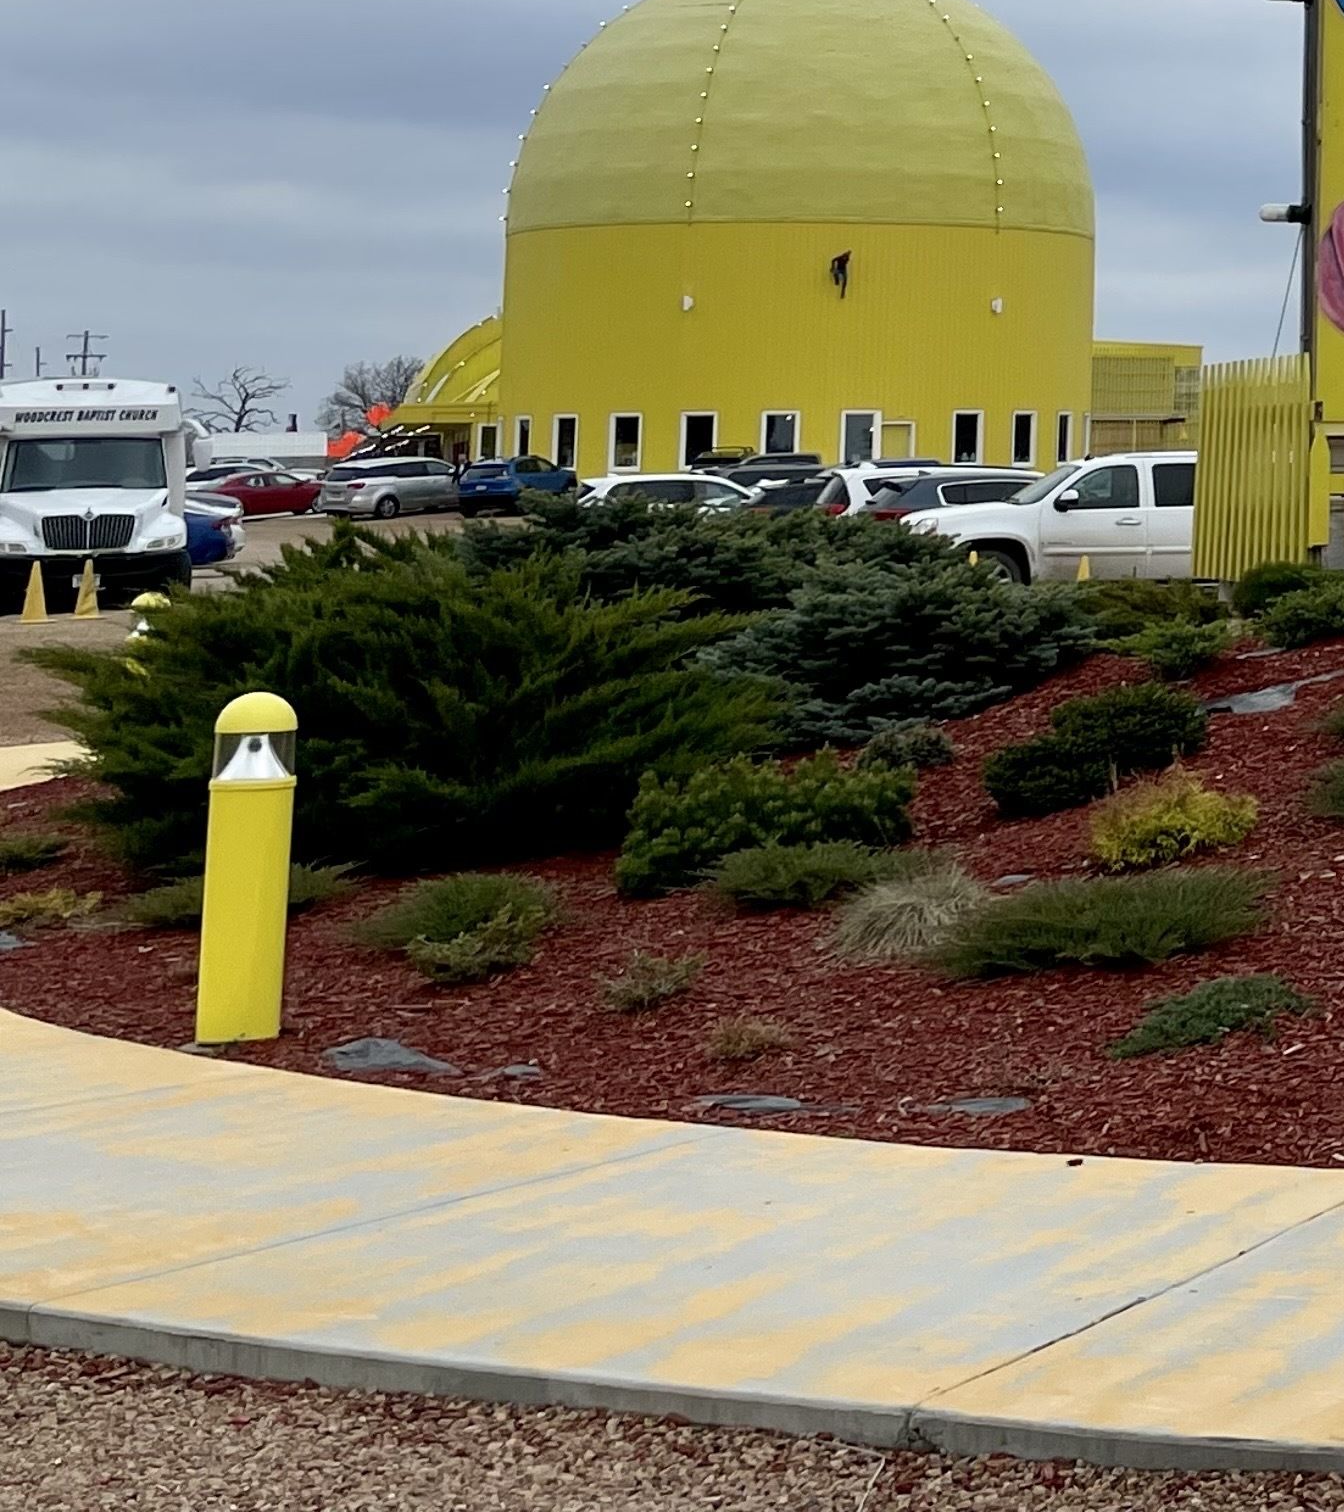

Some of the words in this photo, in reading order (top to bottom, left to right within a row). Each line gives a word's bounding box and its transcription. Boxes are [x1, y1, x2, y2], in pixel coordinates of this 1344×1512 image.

[15, 410, 75, 424] WOODCREST
[77, 409, 116, 422] BAPTIST
[119, 408, 158, 421] CHURCH
